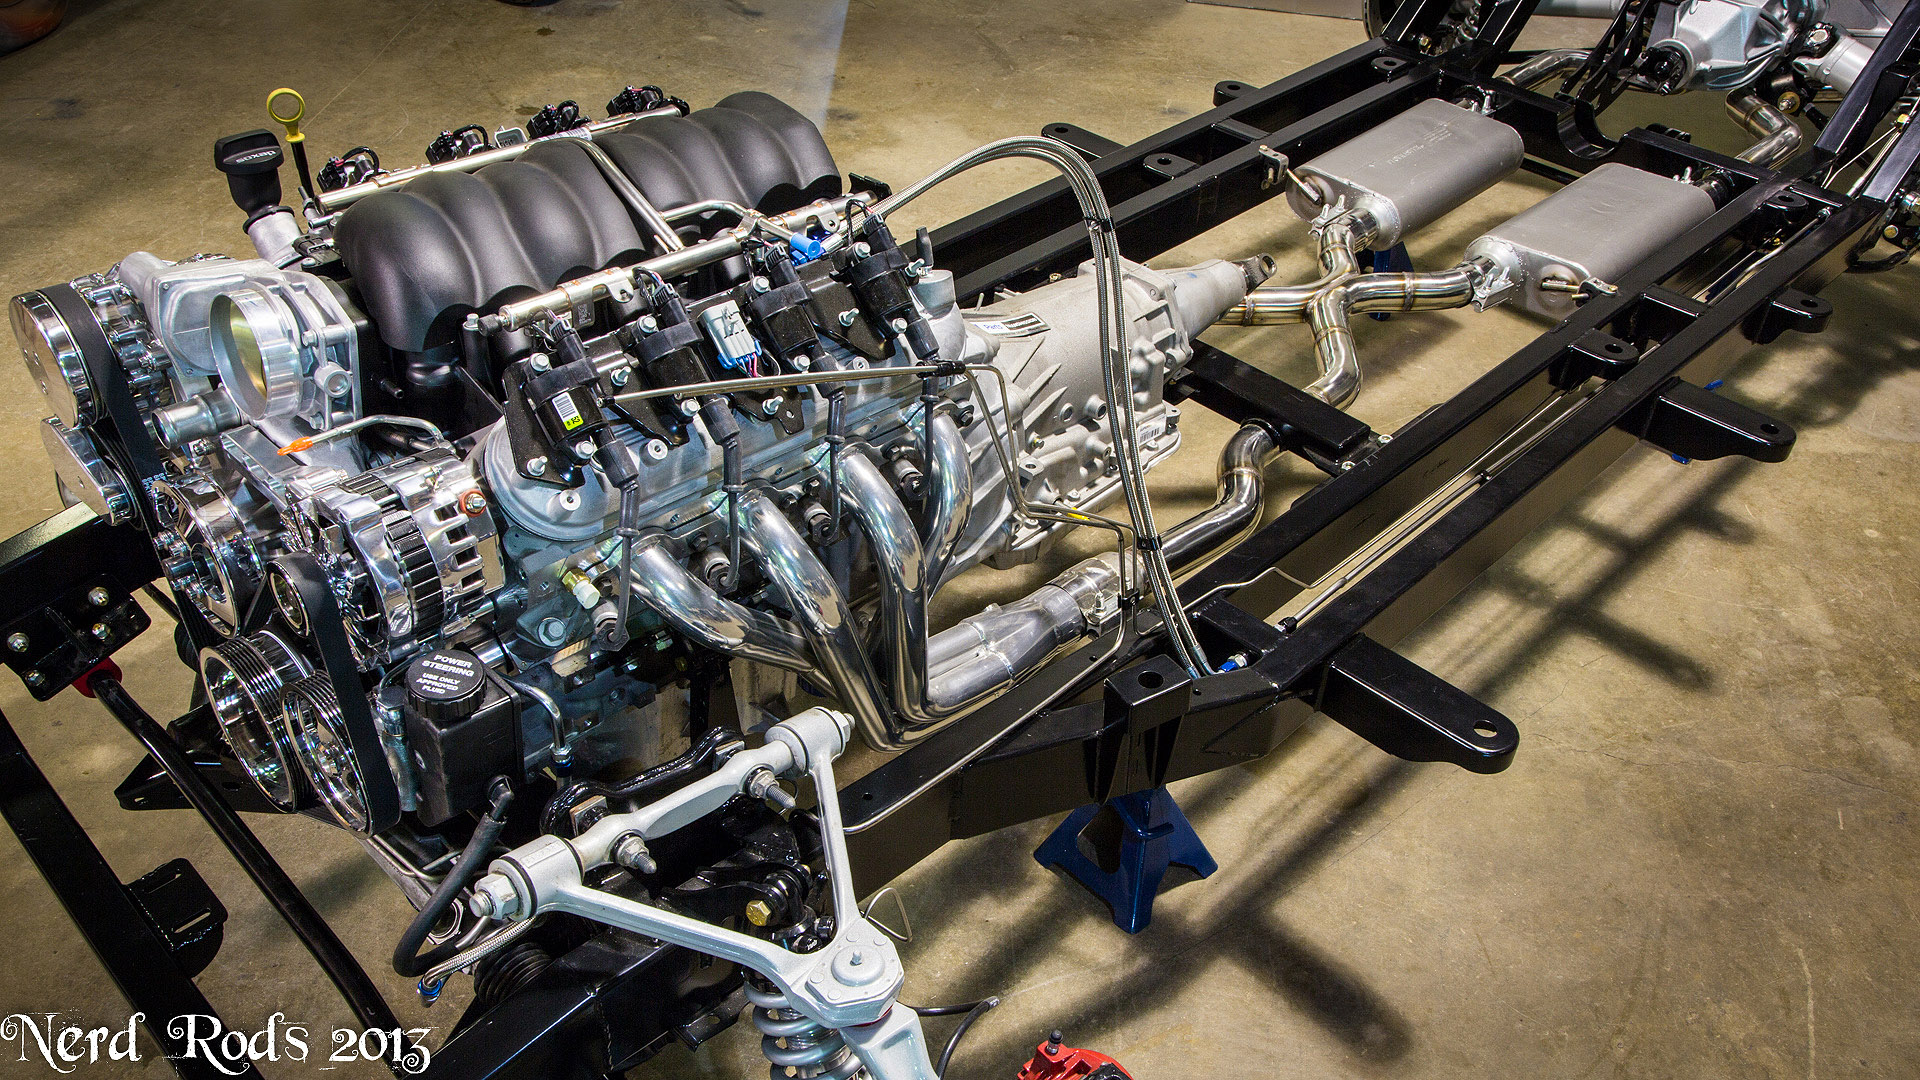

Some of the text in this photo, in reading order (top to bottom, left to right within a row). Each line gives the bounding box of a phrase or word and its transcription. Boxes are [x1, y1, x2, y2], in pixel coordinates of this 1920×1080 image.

[235, 150, 277, 164] dexos
[433, 654, 473, 668] POWER
[421, 660, 475, 677] STEERING
[416, 677, 459, 691] APPROVED
[422, 672, 461, 685] USE ONLY
[421, 684, 446, 695] FLUID
